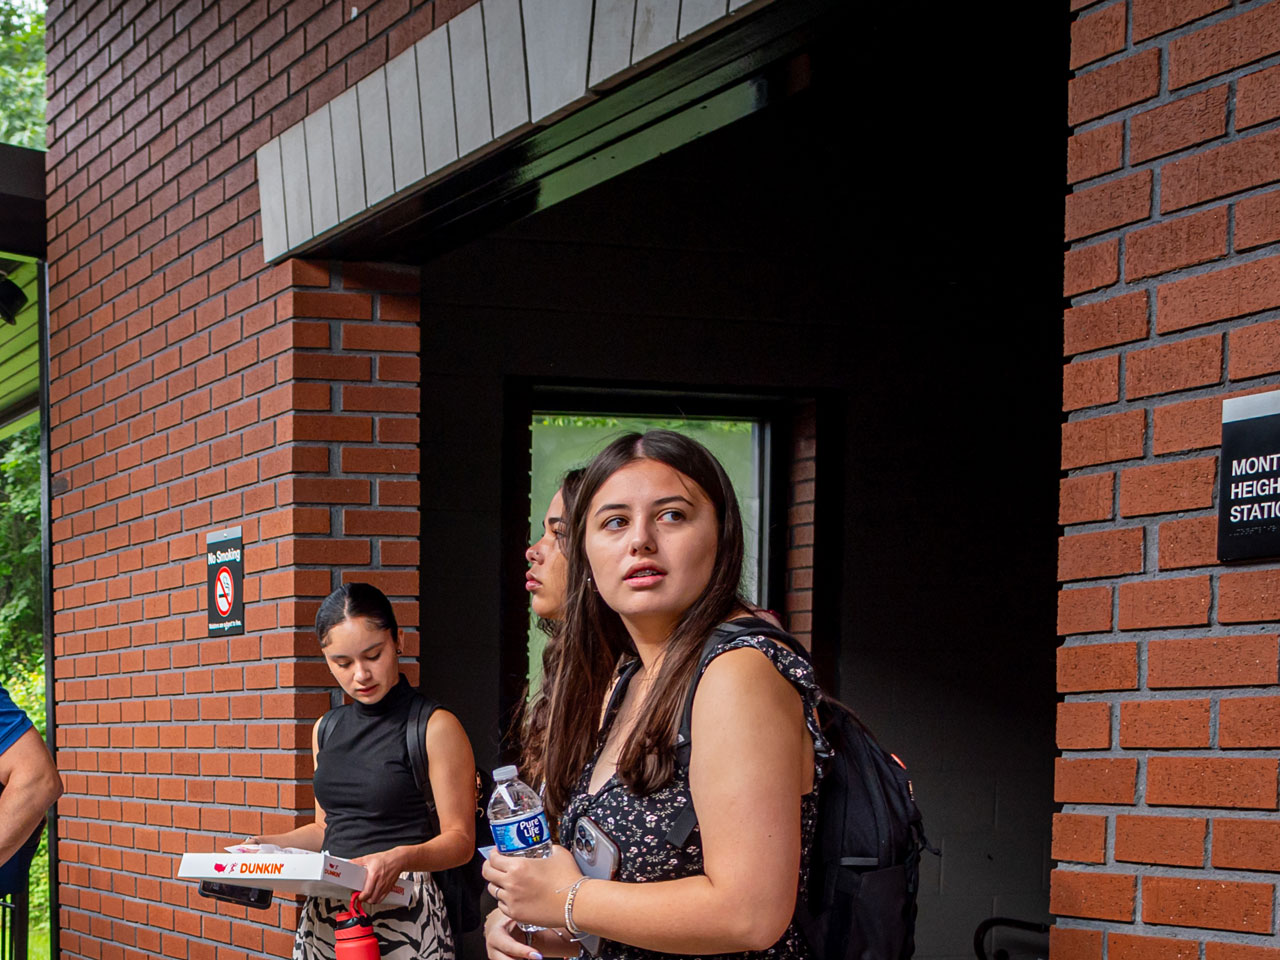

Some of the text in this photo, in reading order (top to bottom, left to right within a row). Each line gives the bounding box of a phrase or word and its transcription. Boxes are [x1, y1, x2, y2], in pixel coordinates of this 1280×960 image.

[208, 547, 241, 566] No Smoking
[520, 817, 540, 830] Pure
[524, 826, 540, 837] Life
[239, 862, 285, 875] DUNKIN'
